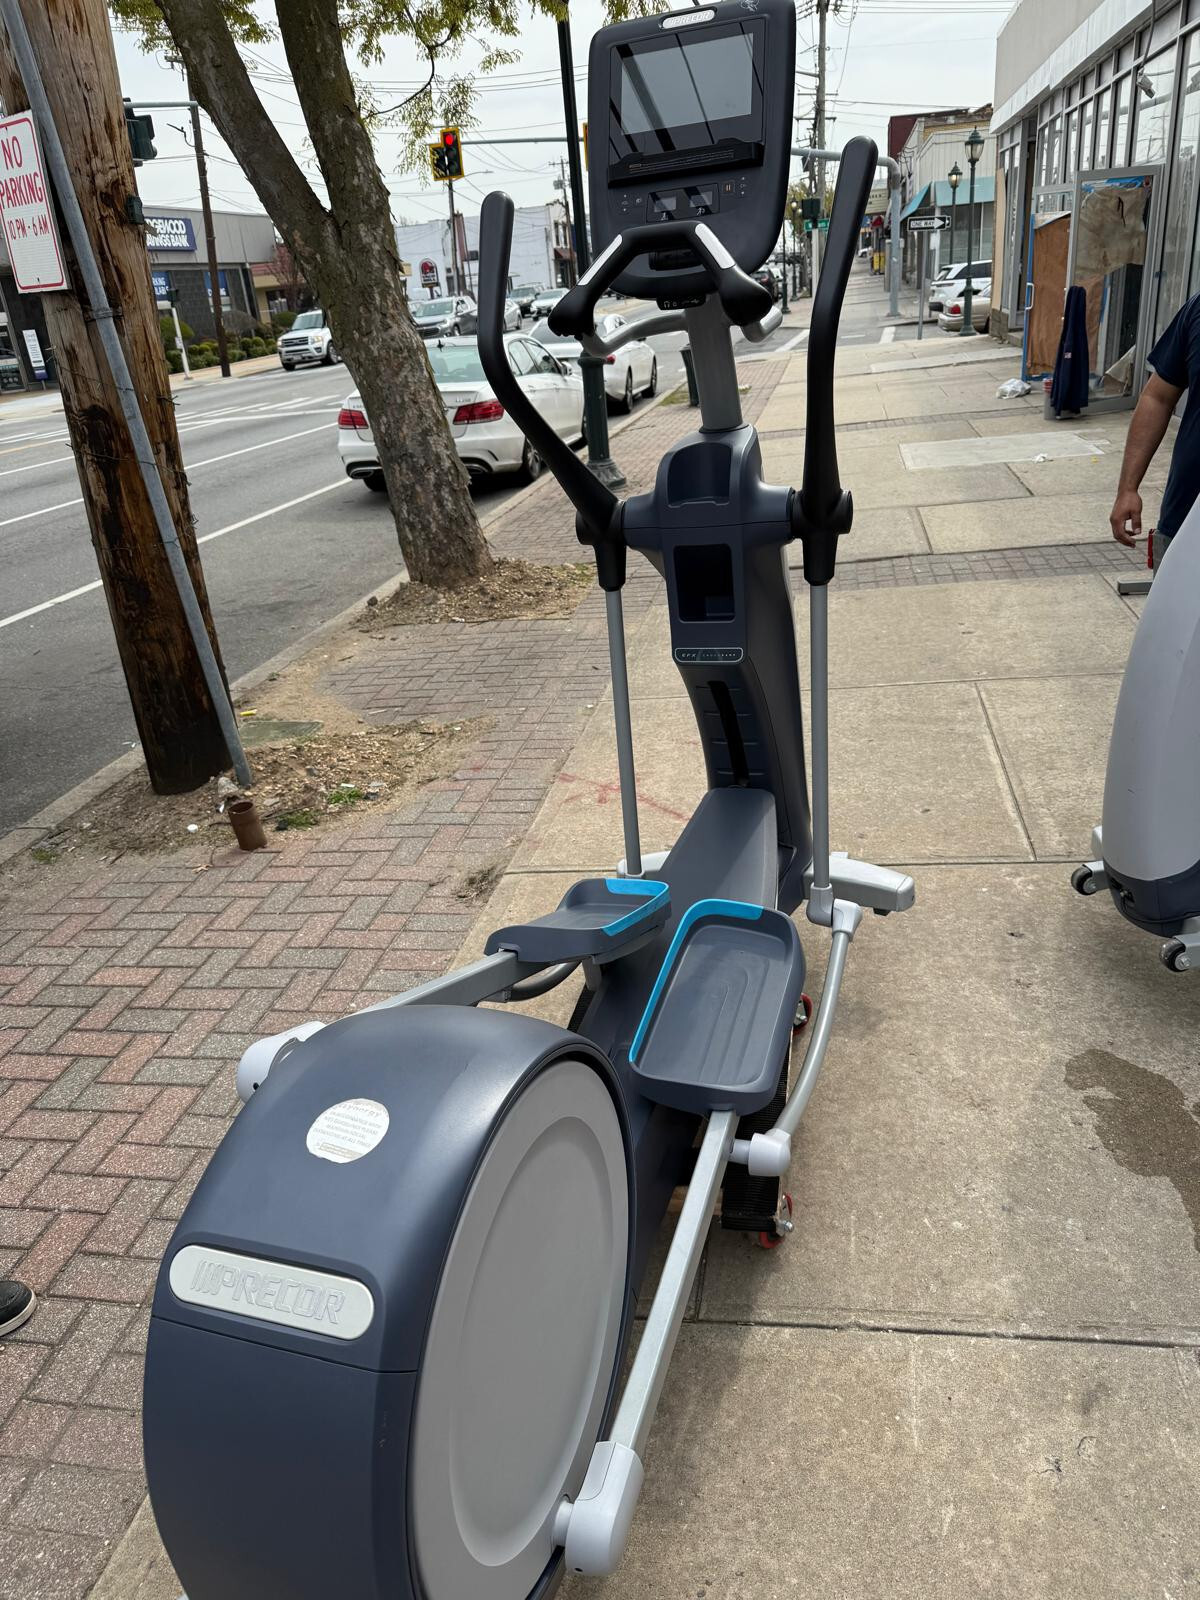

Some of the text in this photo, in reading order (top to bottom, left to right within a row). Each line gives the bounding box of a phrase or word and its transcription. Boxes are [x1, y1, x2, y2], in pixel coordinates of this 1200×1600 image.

[1, 135, 23, 170] NO
[0, 172, 44, 209] PARKING
[8, 220, 16, 240] 10
[15, 218, 27, 238] PM
[32, 217, 38, 236] 6
[38, 214, 49, 234] AM
[170, 235, 190, 247] BANK
[191, 1259, 346, 1324] PRECOR
